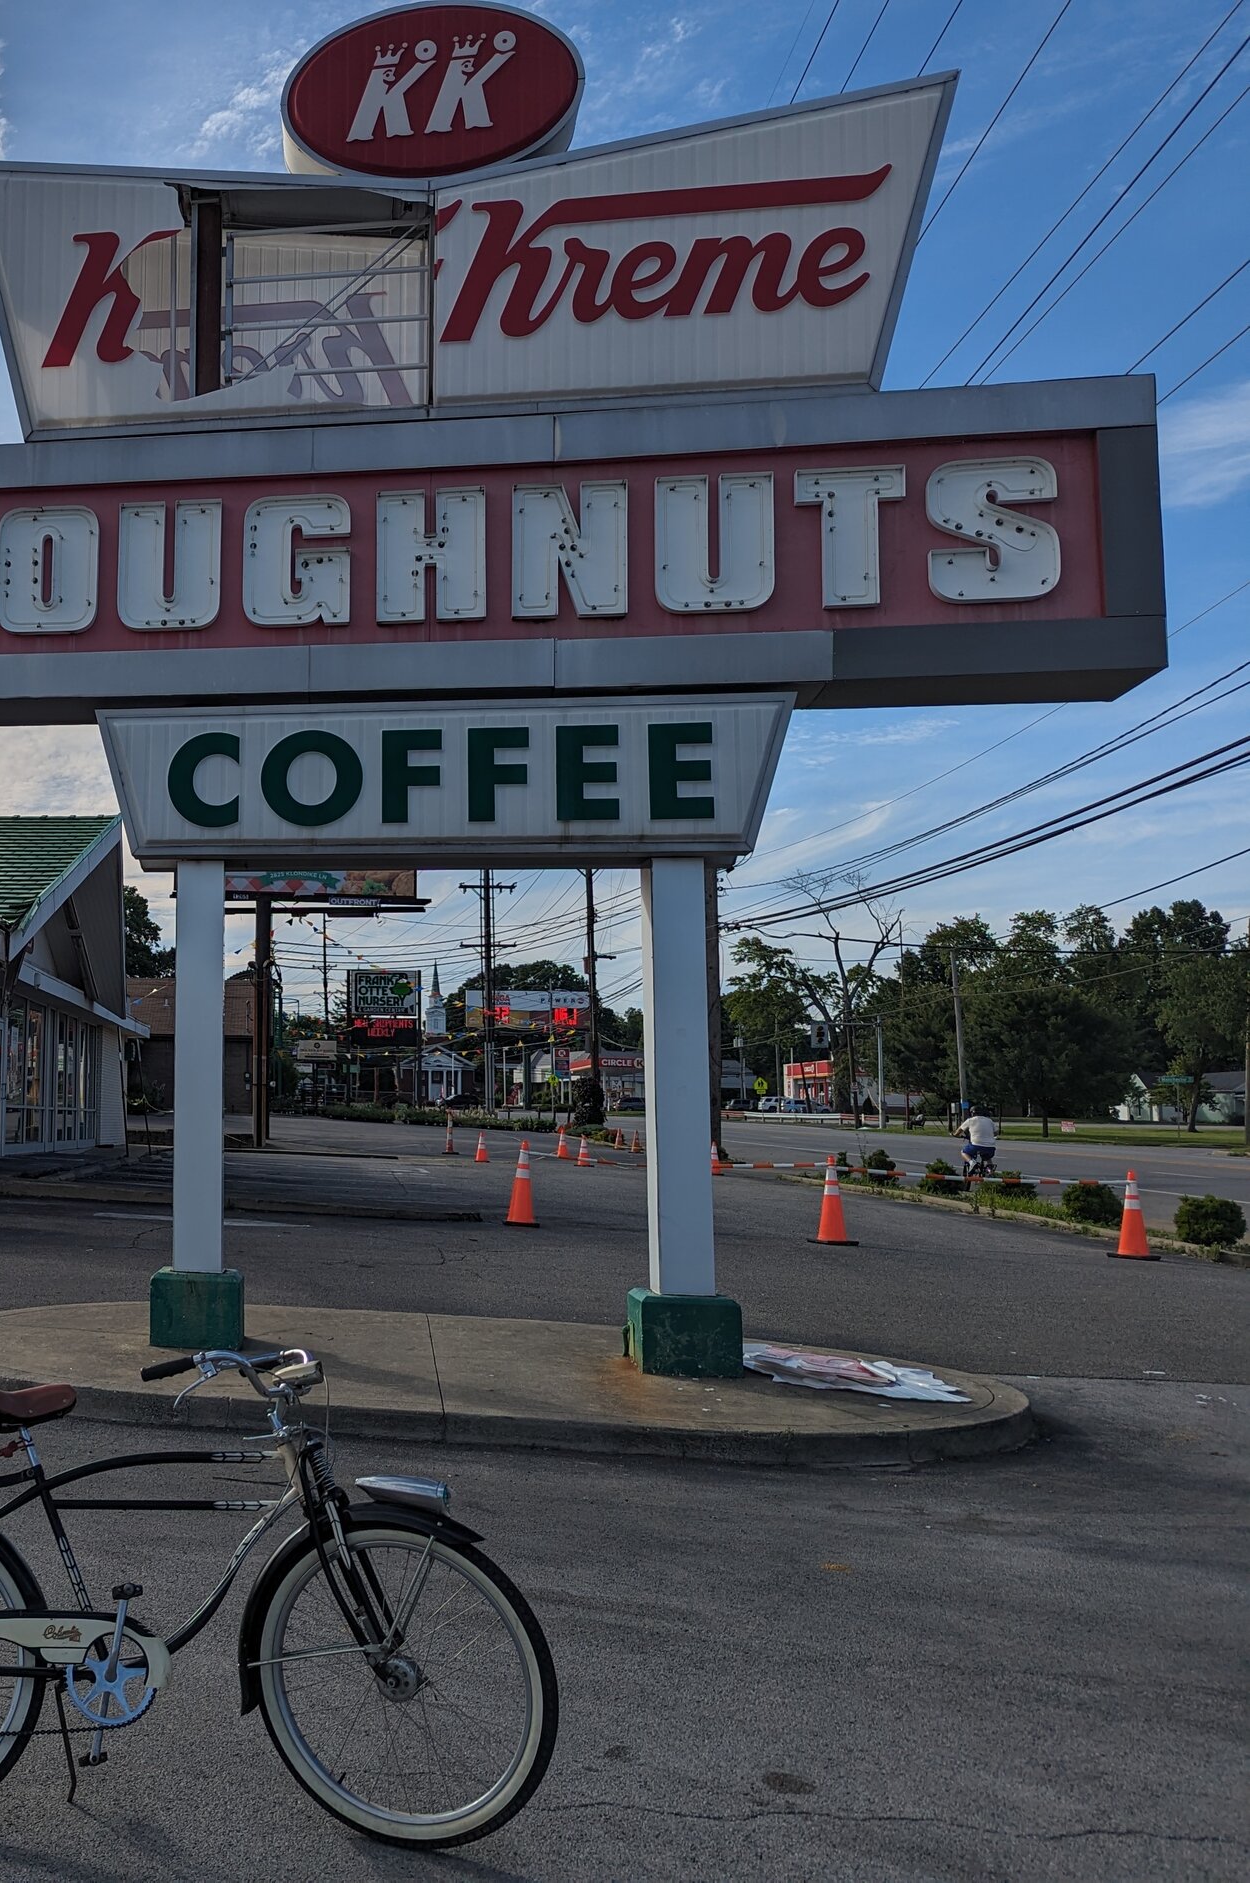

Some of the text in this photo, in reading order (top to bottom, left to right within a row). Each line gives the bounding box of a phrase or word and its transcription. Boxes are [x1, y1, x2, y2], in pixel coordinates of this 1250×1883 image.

[440, 164, 893, 343] Kreme
[167, 721, 716, 828] COFFEE
[286, 870, 317, 878] KLONDIKE
[358, 985, 388, 995] OTTE
[358, 996, 405, 1007] NURSERY
[367, 1027, 395, 1037] WEEKLY
[601, 1058, 632, 1067] CIRCLE
